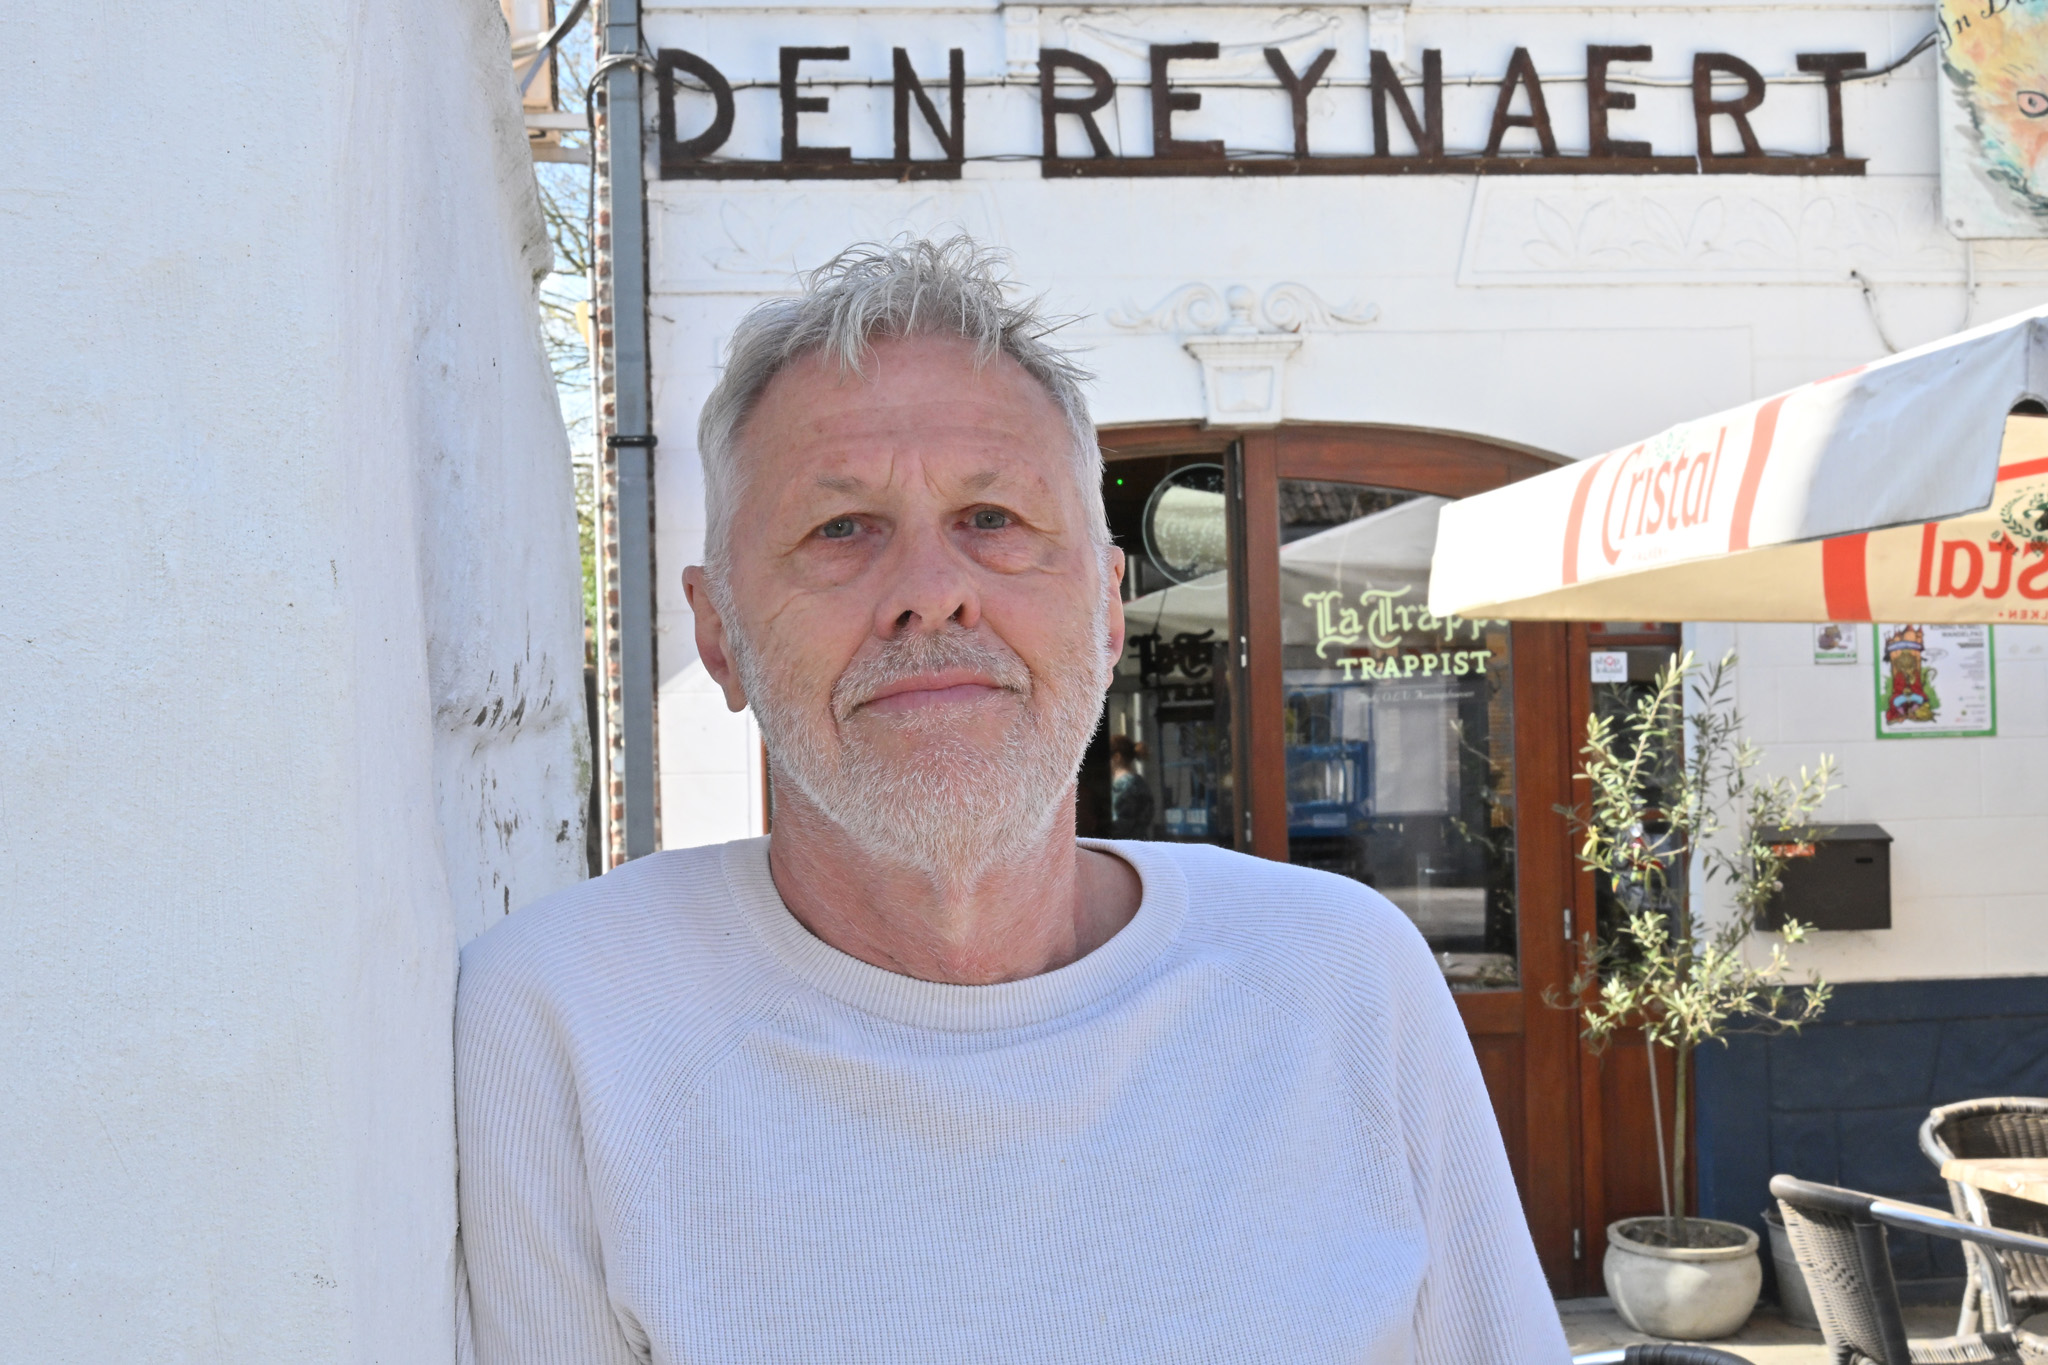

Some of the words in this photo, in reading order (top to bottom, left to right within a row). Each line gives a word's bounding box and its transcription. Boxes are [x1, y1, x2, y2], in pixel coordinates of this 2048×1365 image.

[657, 46, 964, 162] DEN
[1037, 41, 1867, 160] REYNAERT
[1601, 425, 1728, 566] Cristal
[1302, 590, 1364, 660] La
[1336, 650, 1492, 681] TRAPPIST
